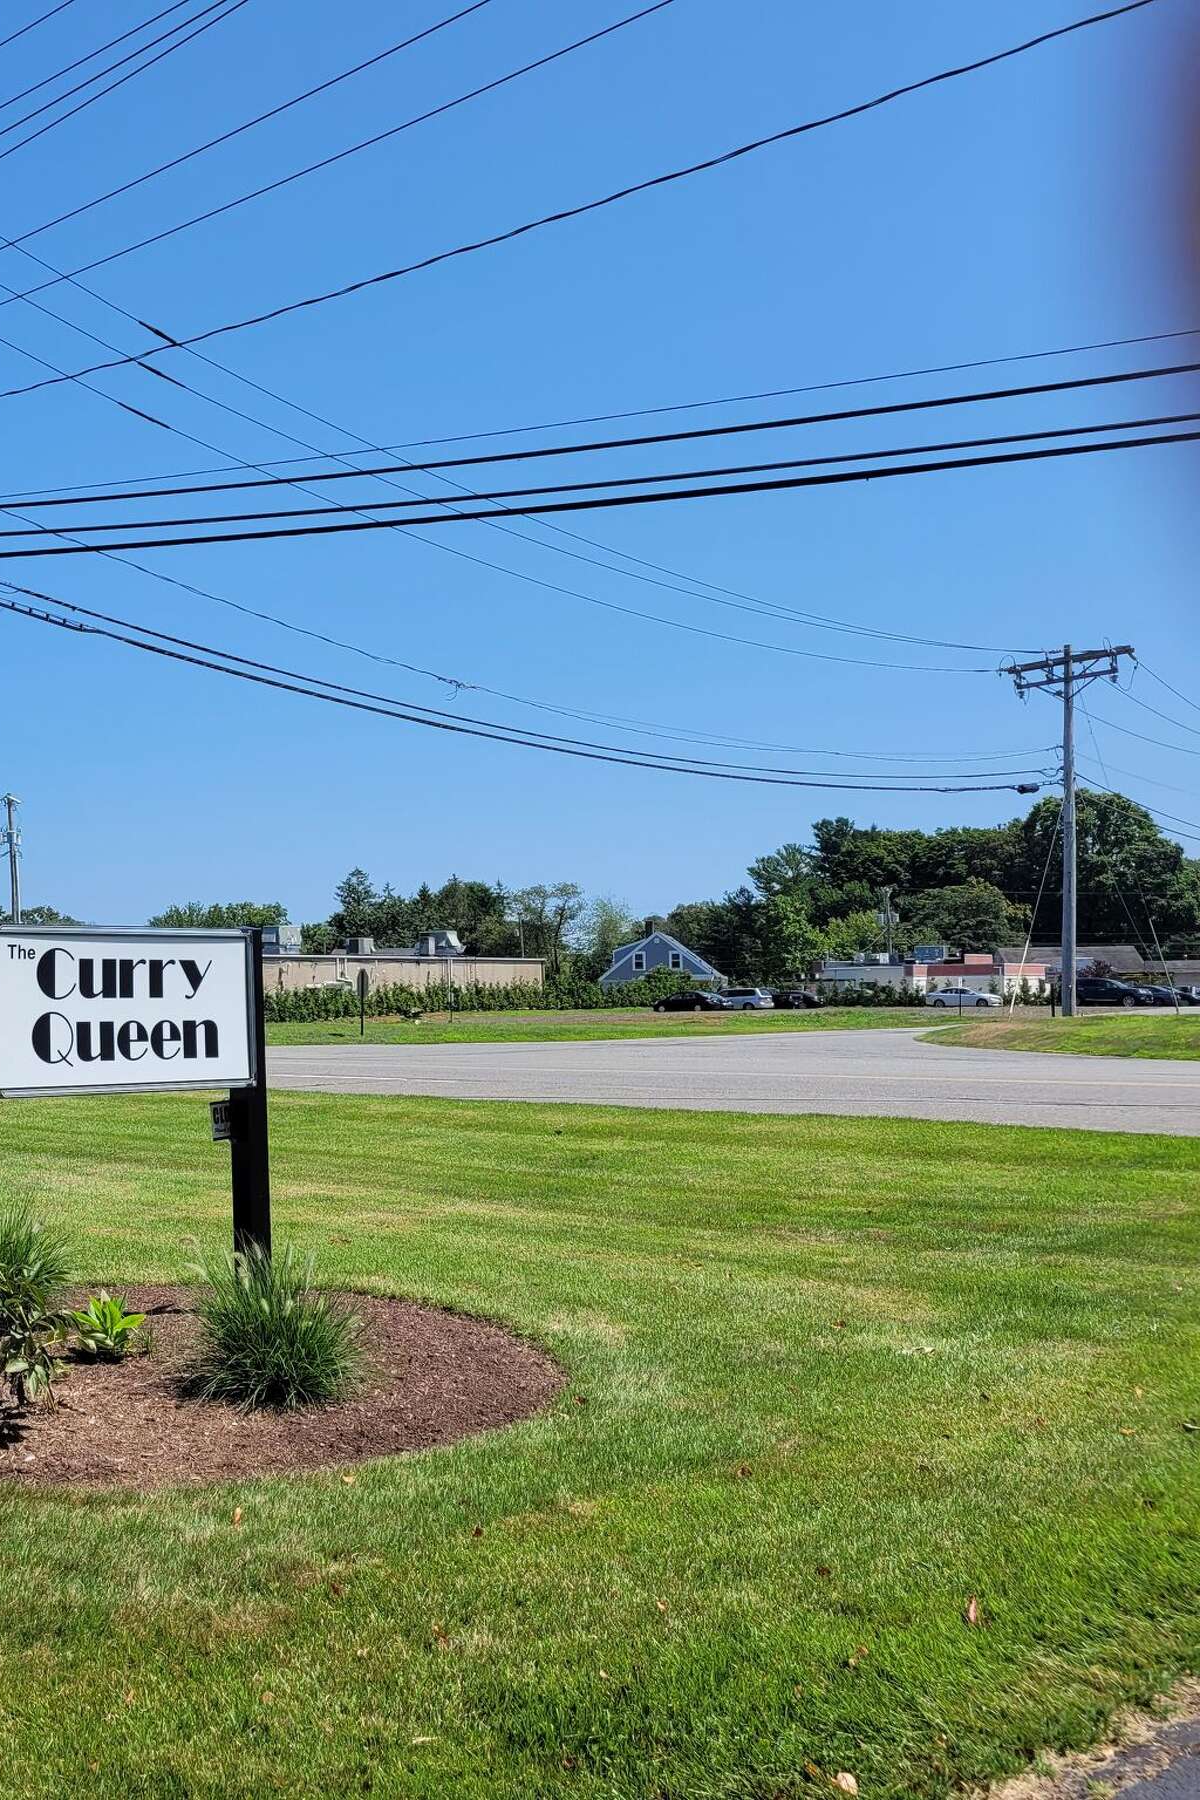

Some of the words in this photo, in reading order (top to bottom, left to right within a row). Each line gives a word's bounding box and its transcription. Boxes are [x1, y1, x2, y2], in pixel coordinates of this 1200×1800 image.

[8, 944, 36, 960] The
[37, 947, 212, 1000] Curry
[32, 1011, 219, 1067] Queen
